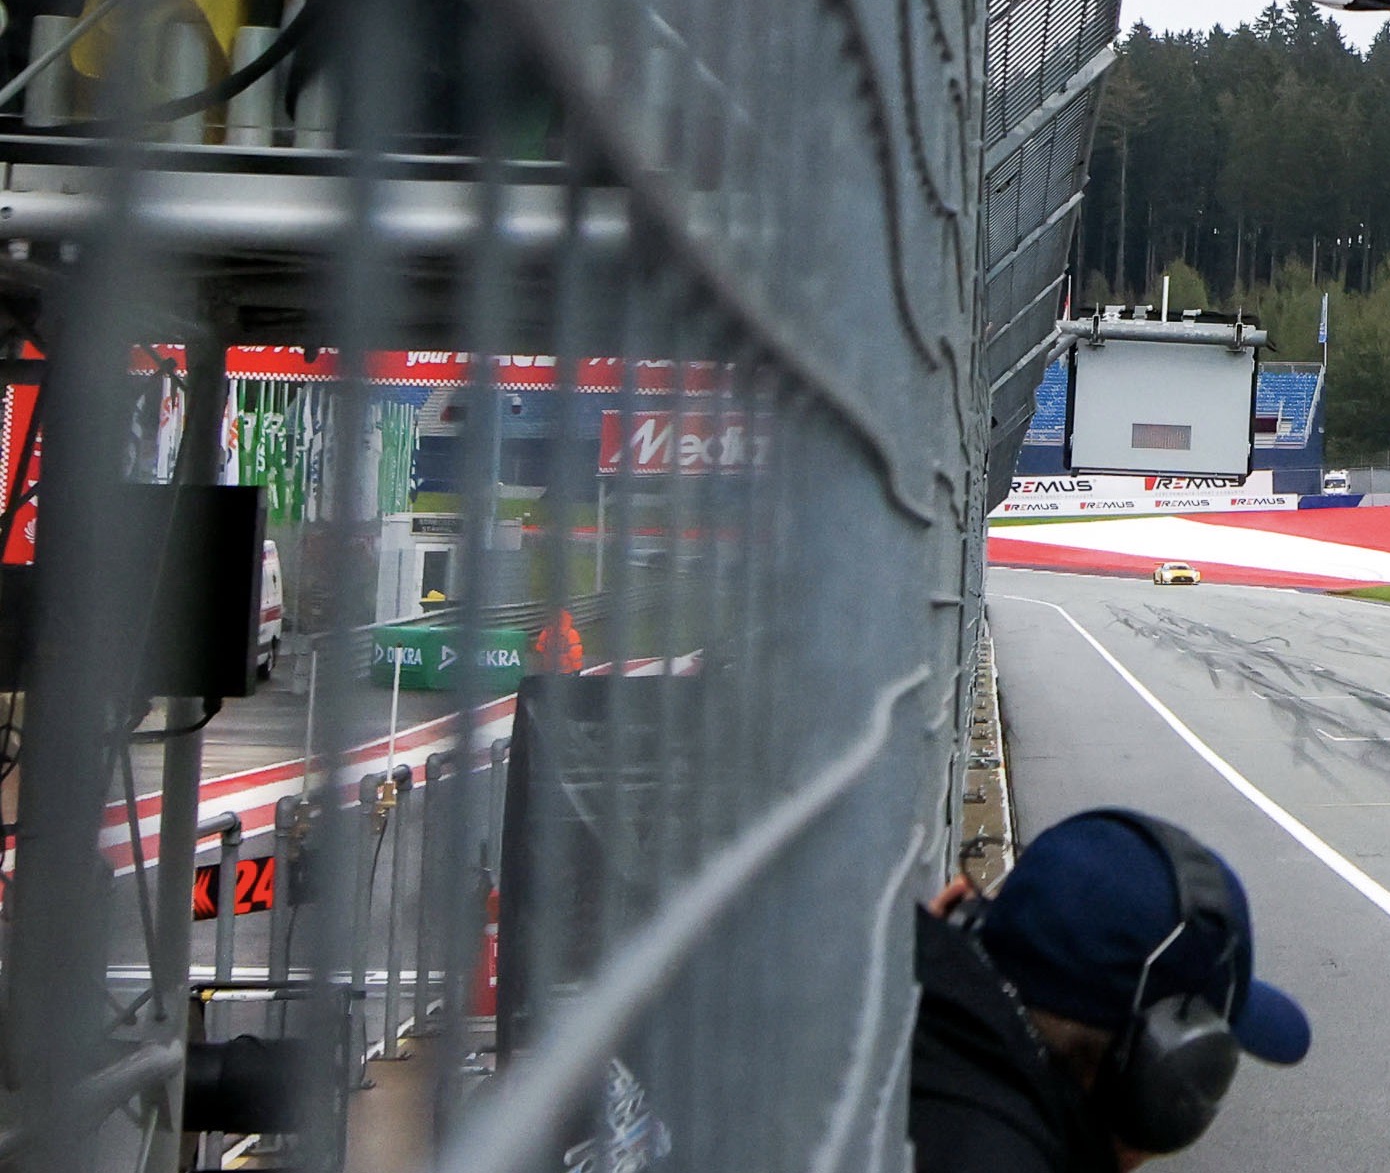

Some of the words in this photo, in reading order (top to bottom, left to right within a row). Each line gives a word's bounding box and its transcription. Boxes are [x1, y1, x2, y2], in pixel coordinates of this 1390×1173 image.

[1010, 480, 1093, 493] REMUS
[1086, 501, 1135, 510] REMUS
[1161, 499, 1210, 508] REMUS
[1237, 498, 1286, 506] REMUS
[1010, 503, 1059, 511] REMUS
[387, 646, 423, 665] DKRA
